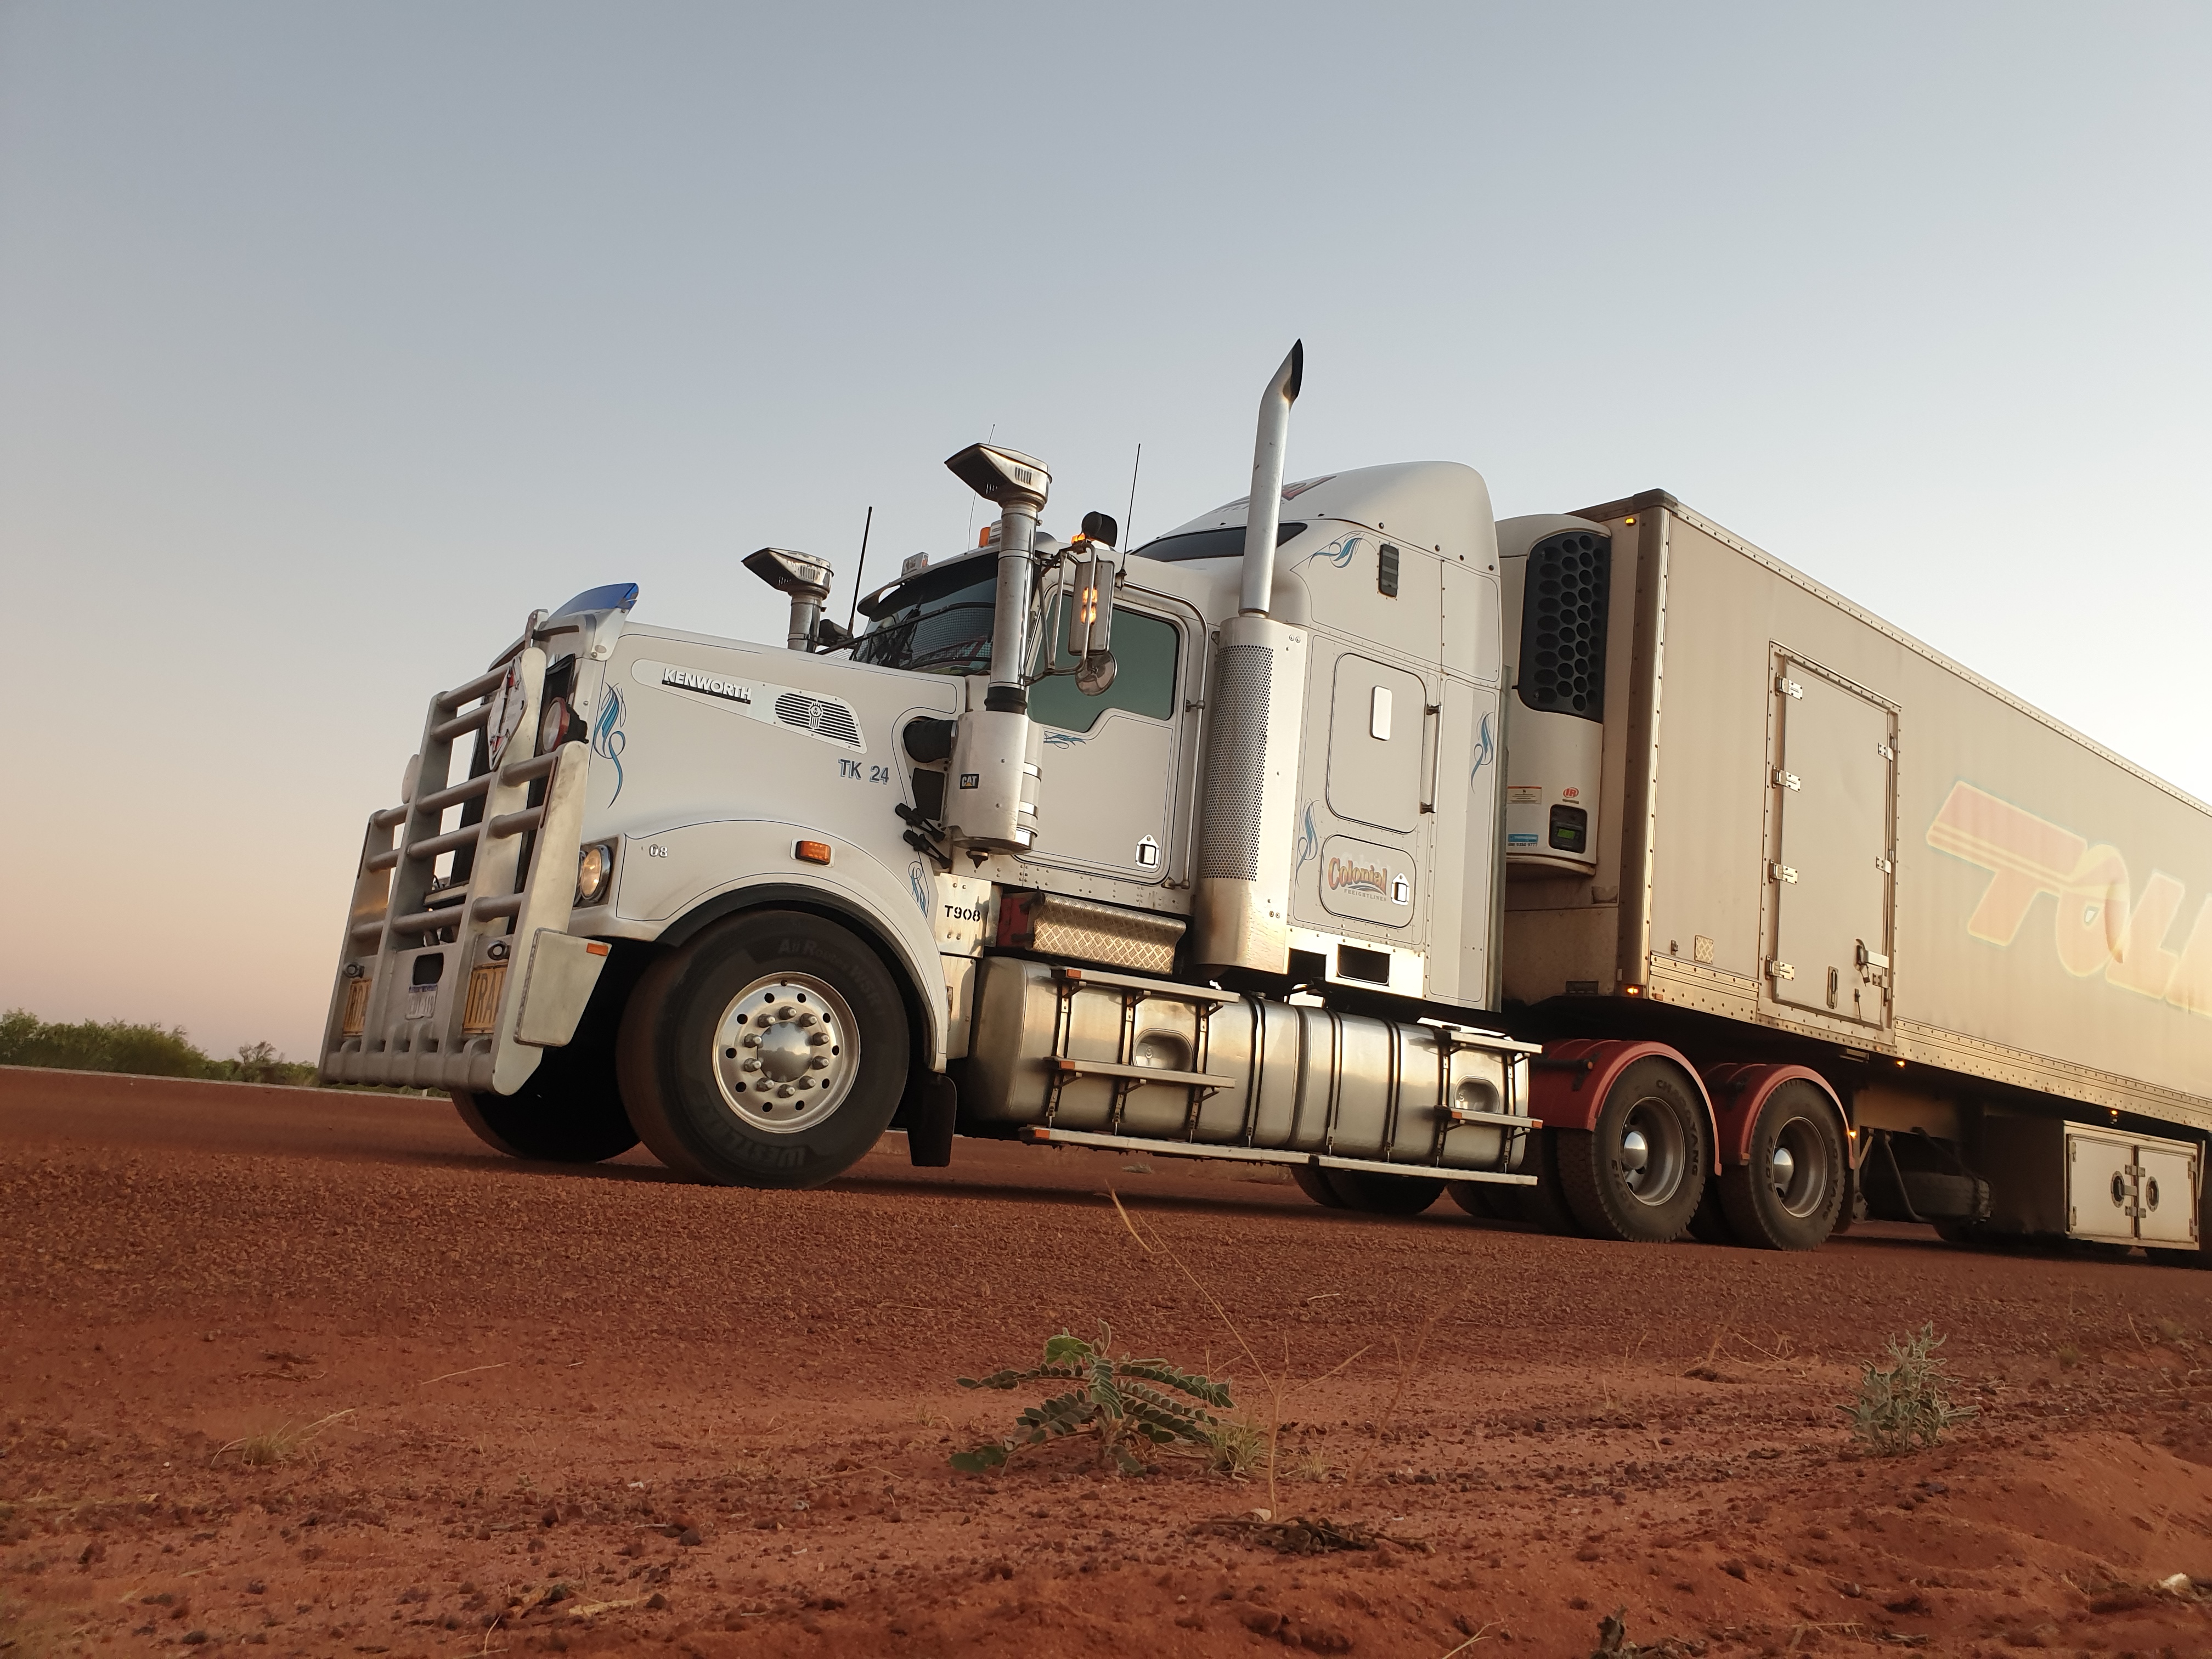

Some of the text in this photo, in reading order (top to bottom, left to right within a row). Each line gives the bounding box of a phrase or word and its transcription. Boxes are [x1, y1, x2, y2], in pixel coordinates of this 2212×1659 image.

[663, 668, 752, 701] KENWORTH
[838, 759, 890, 785] TK 24
[961, 775, 978, 787] CAT
[1328, 856, 1388, 896] Colonial
[1343, 888, 1387, 902] FREIGHTLINES
[944, 904, 981, 923] T908
